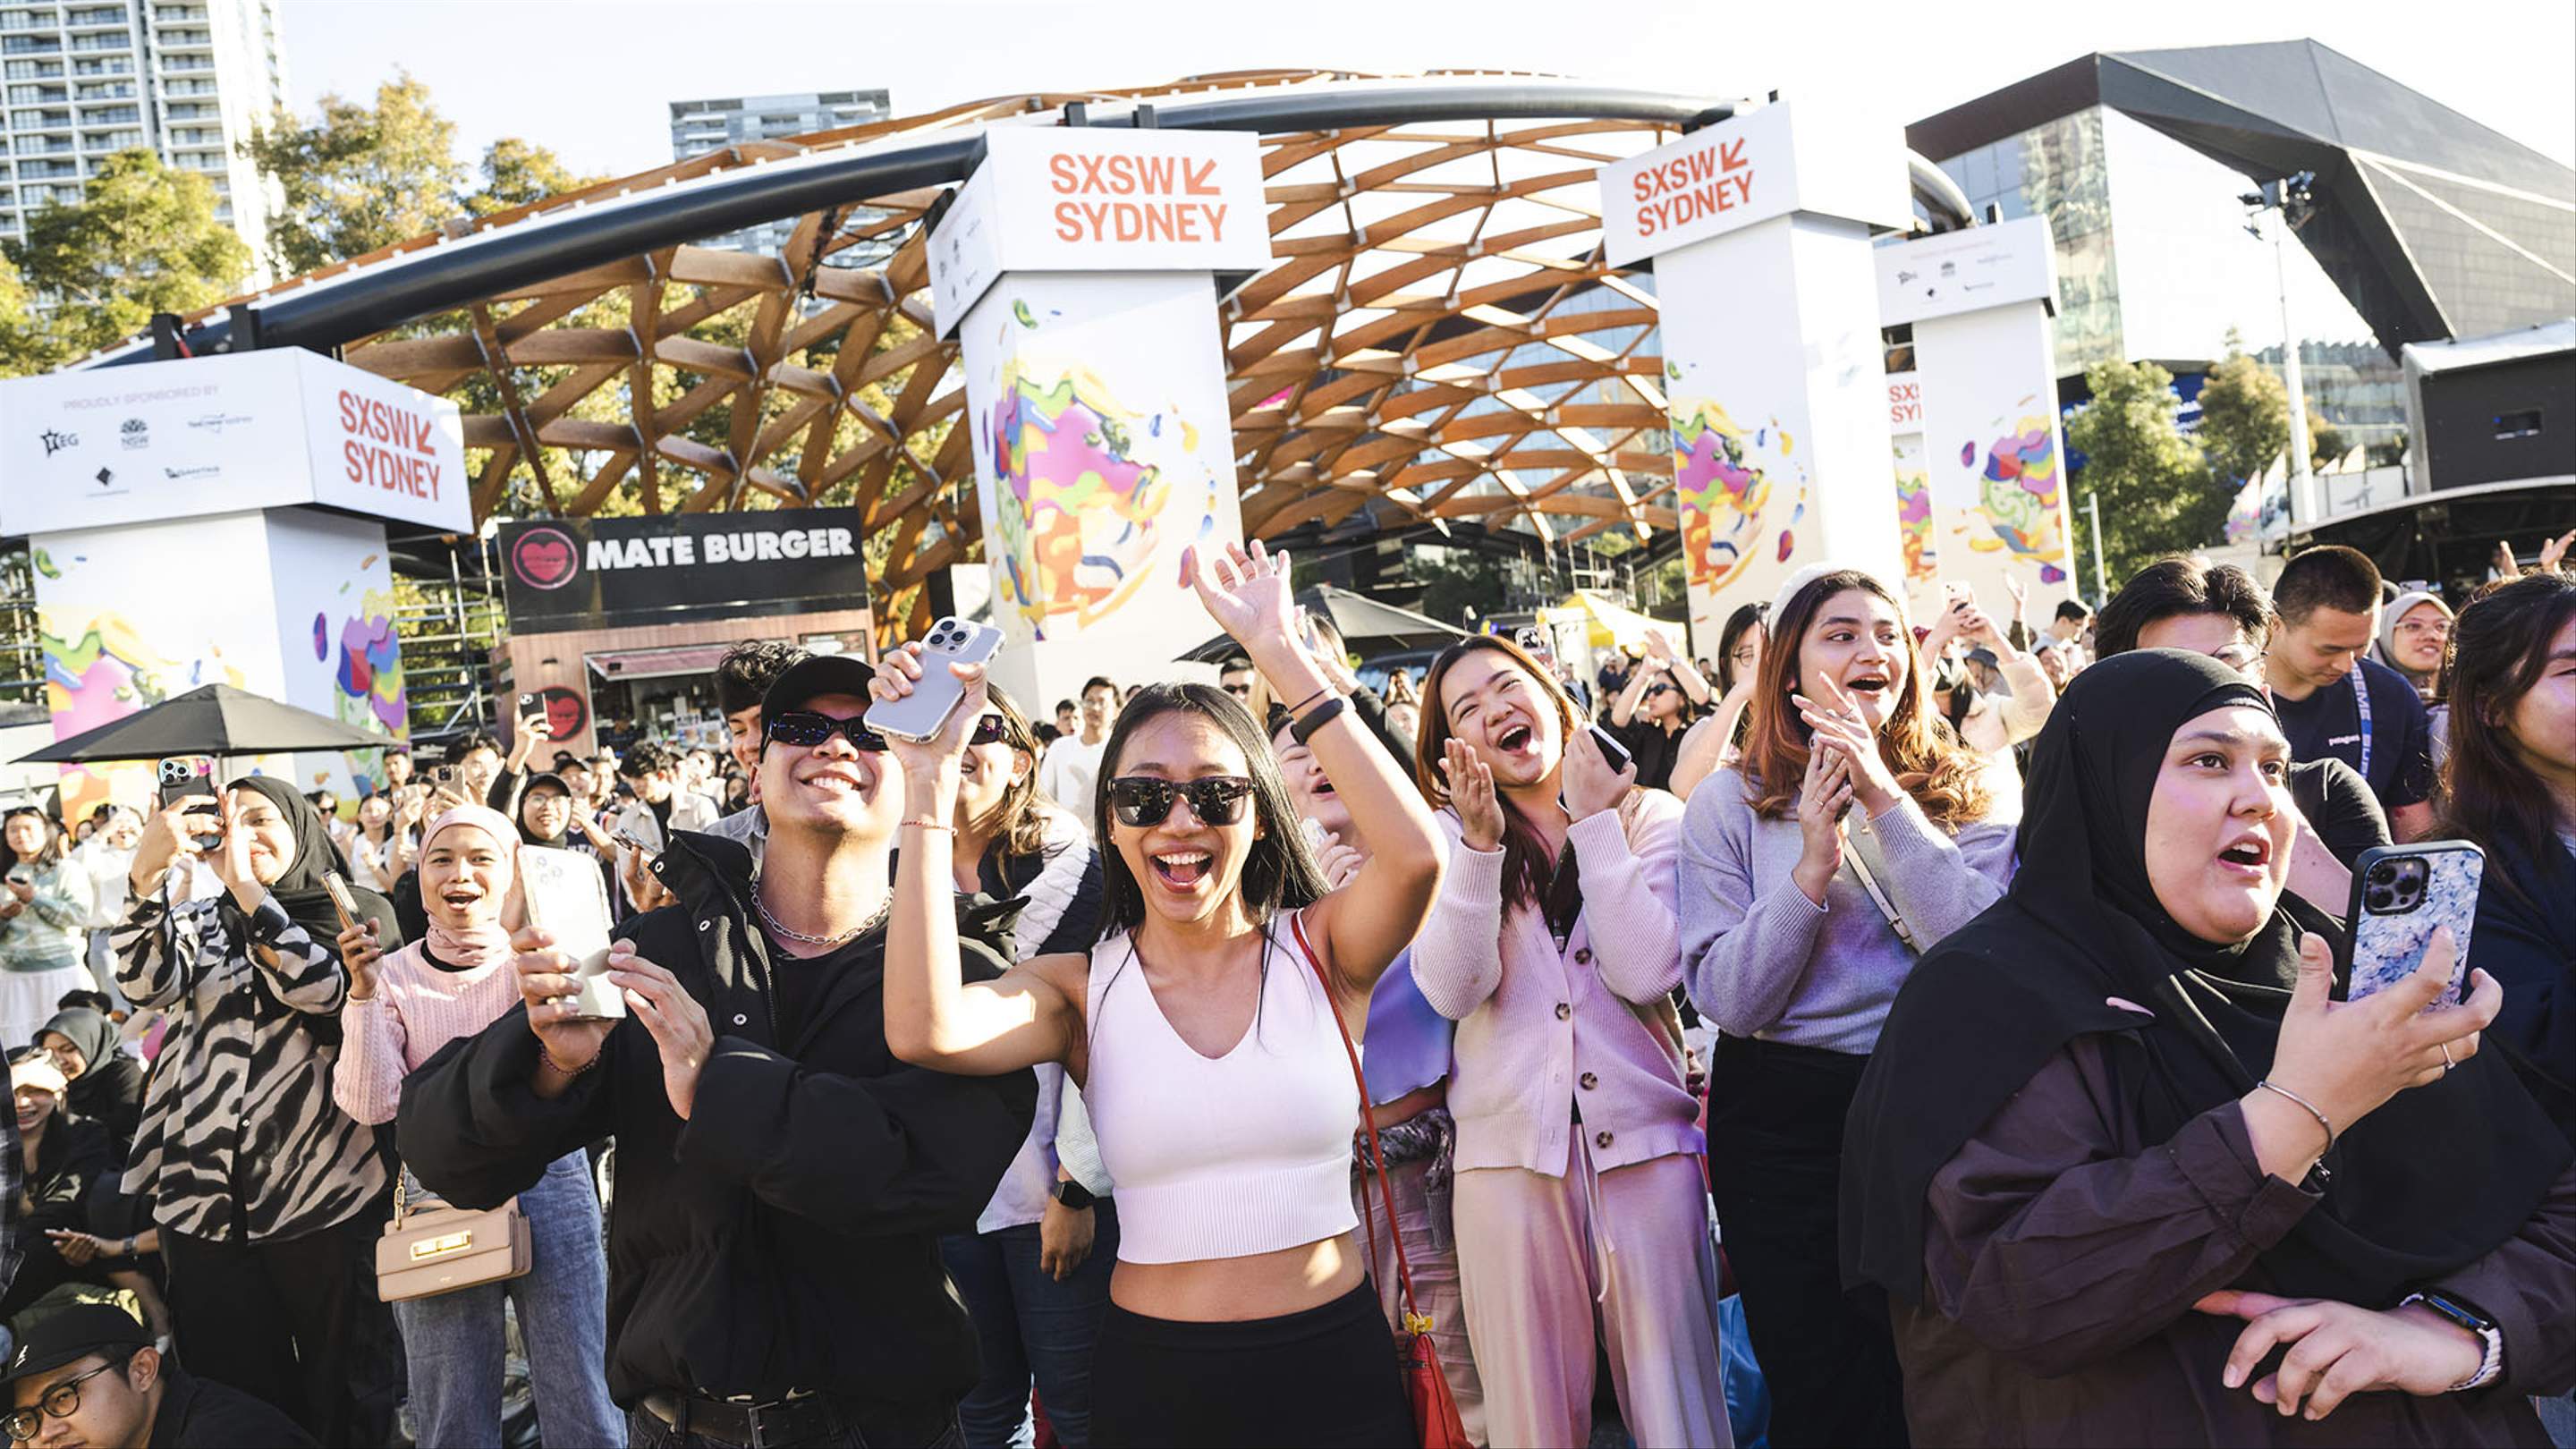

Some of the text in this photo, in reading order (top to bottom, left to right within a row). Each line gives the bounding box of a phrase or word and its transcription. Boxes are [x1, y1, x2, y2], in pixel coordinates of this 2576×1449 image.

[1049, 153, 1175, 195] SXSW
[1632, 146, 1716, 204] SXSW
[1054, 201, 1228, 242] SYDNEY
[1637, 169, 1755, 238] SYDNEY
[64, 396, 120, 411] PROUDLY
[123, 386, 201, 404] SPONSORED
[337, 388, 411, 450] SXSW
[1890, 402, 1922, 423] SY
[343, 439, 440, 503] SYDNEY
[585, 527, 856, 572] MATE BURGER
